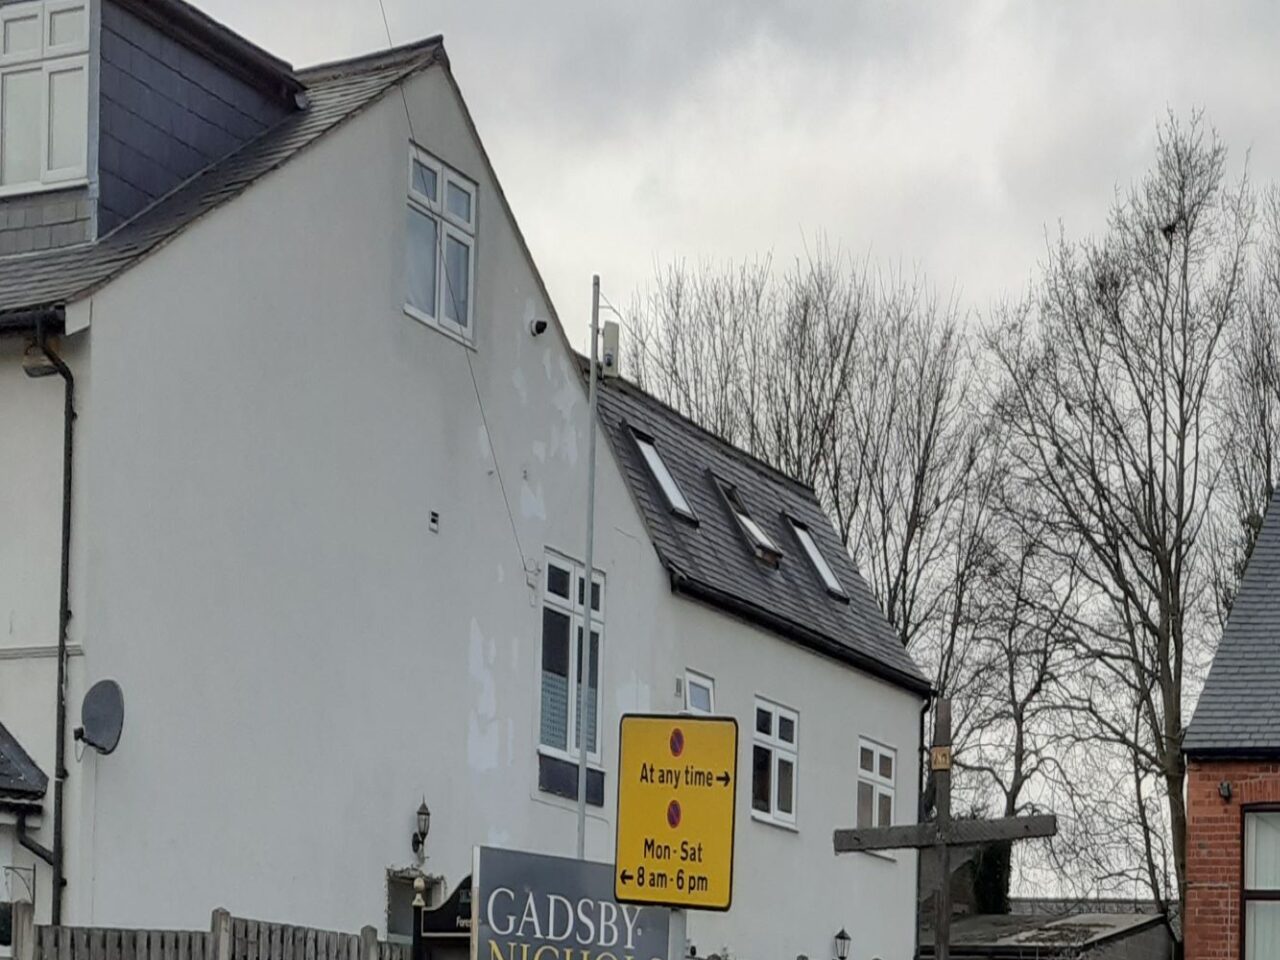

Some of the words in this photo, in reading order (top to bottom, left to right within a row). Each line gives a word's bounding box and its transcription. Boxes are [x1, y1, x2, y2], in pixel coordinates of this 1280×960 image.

[640, 763, 655, 784] At
[658, 768, 681, 789] any
[684, 765, 713, 787] time
[643, 838, 670, 860] Mon
[680, 841, 703, 863] Sat
[637, 866, 645, 887] 8
[688, 874, 708, 894] pm
[487, 887, 643, 949] GADSBY
